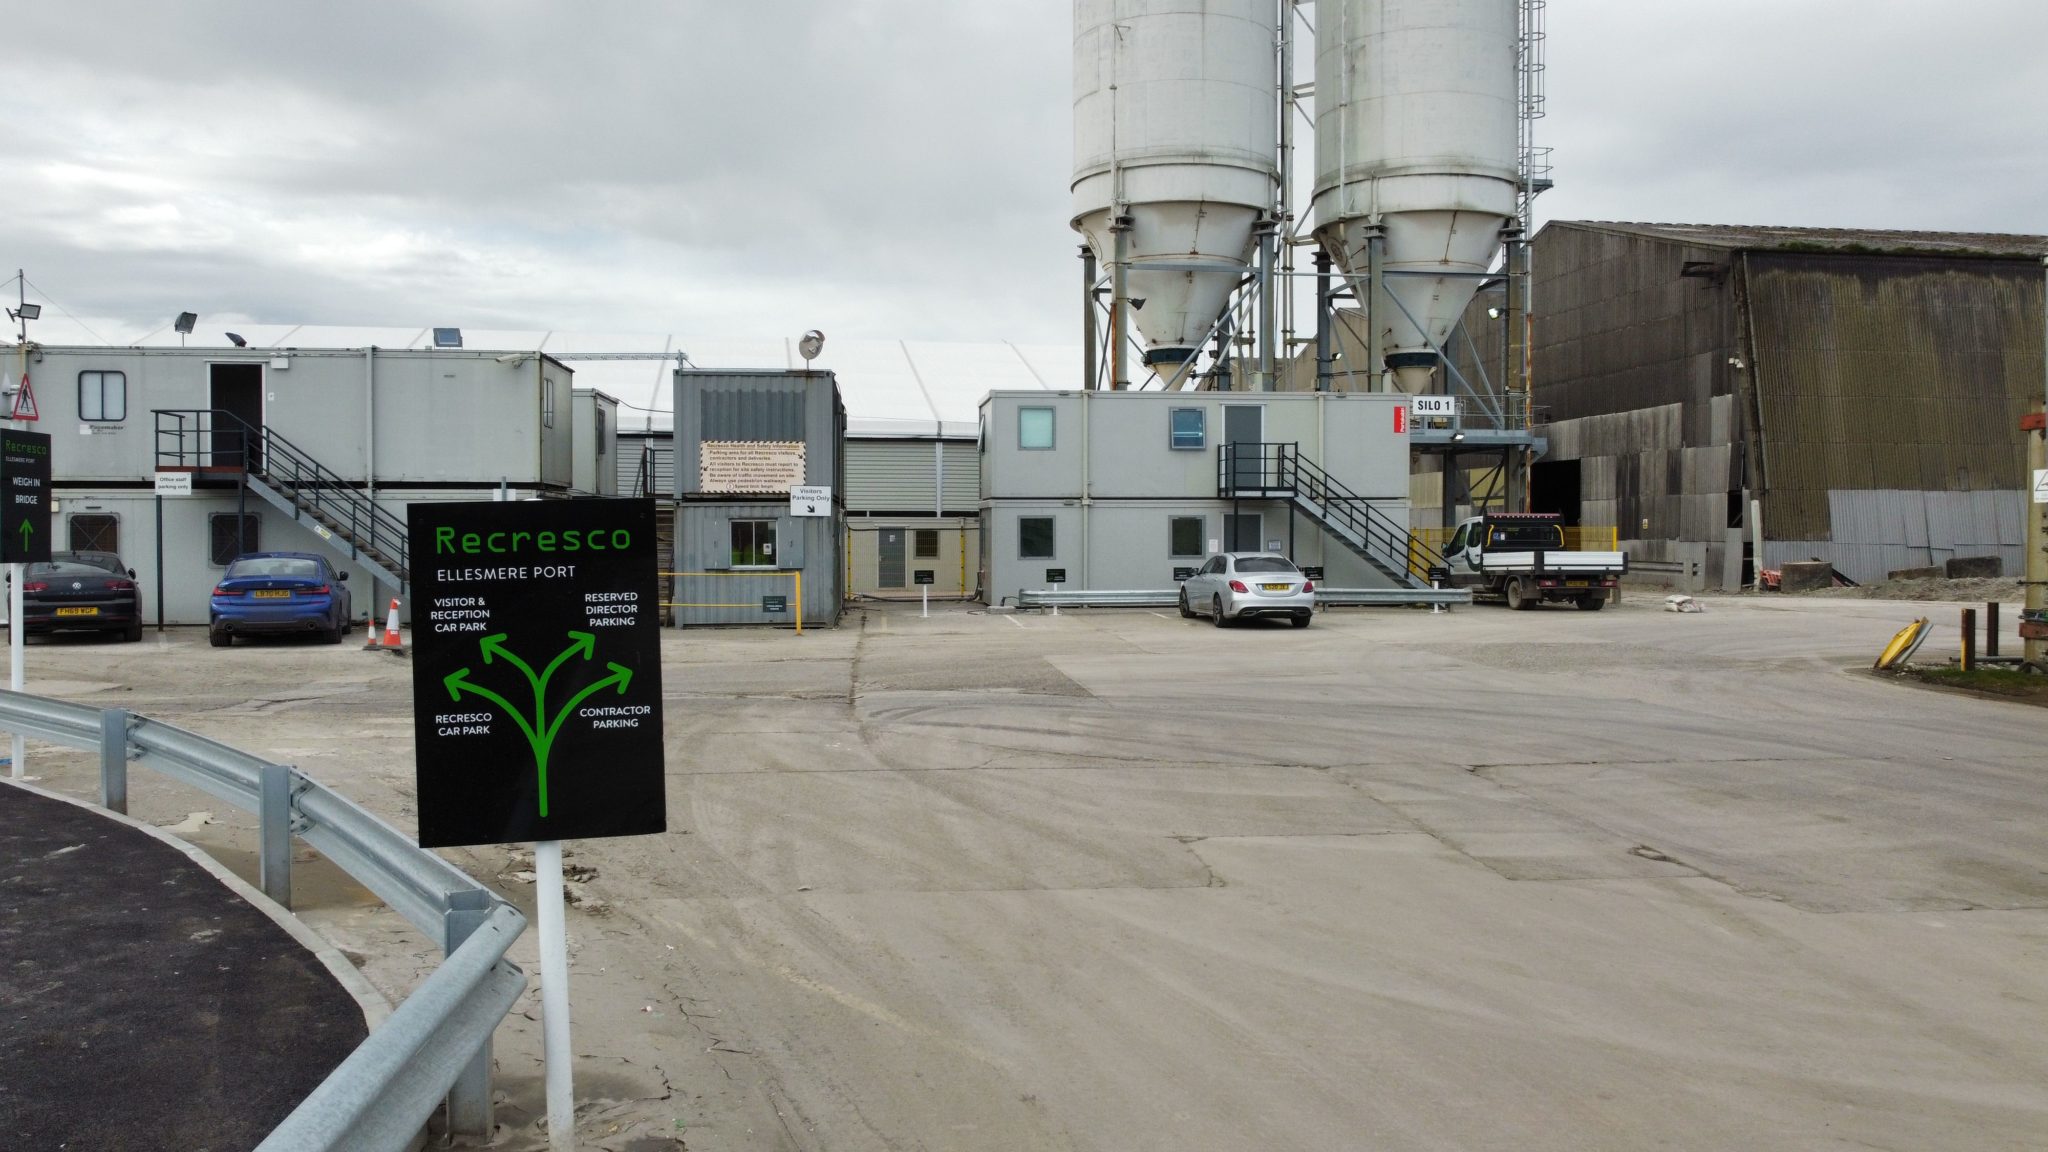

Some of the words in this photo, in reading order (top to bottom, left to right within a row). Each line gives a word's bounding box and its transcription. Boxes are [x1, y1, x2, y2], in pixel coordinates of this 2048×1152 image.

[1418, 400, 1440, 410] SILO
[1445, 400, 1450, 410] 1
[5, 440, 47, 455] Recresco
[13, 477, 32, 487] WEIGH
[33, 478, 41, 487] IN
[15, 495, 38, 504] BRIDGE
[435, 526, 631, 554] Recresco
[437, 567, 528, 581] ELLESMERE
[534, 565, 576, 578] PORT
[434, 597, 476, 607] VISITOR
[478, 597, 486, 606] &
[585, 592, 638, 602] RESERVED
[430, 609, 490, 620] RECEPTION
[585, 604, 638, 615] DIRECTOR
[434, 623, 457, 633] CAR
[459, 622, 487, 632] PARK
[589, 617, 635, 627] PARKING
[580, 705, 651, 717] CONTRACTOR
[435, 712, 492, 724] RECRESCO
[593, 718, 639, 729] PARKING
[438, 727, 461, 737] CAR
[462, 725, 490, 735] PARK
